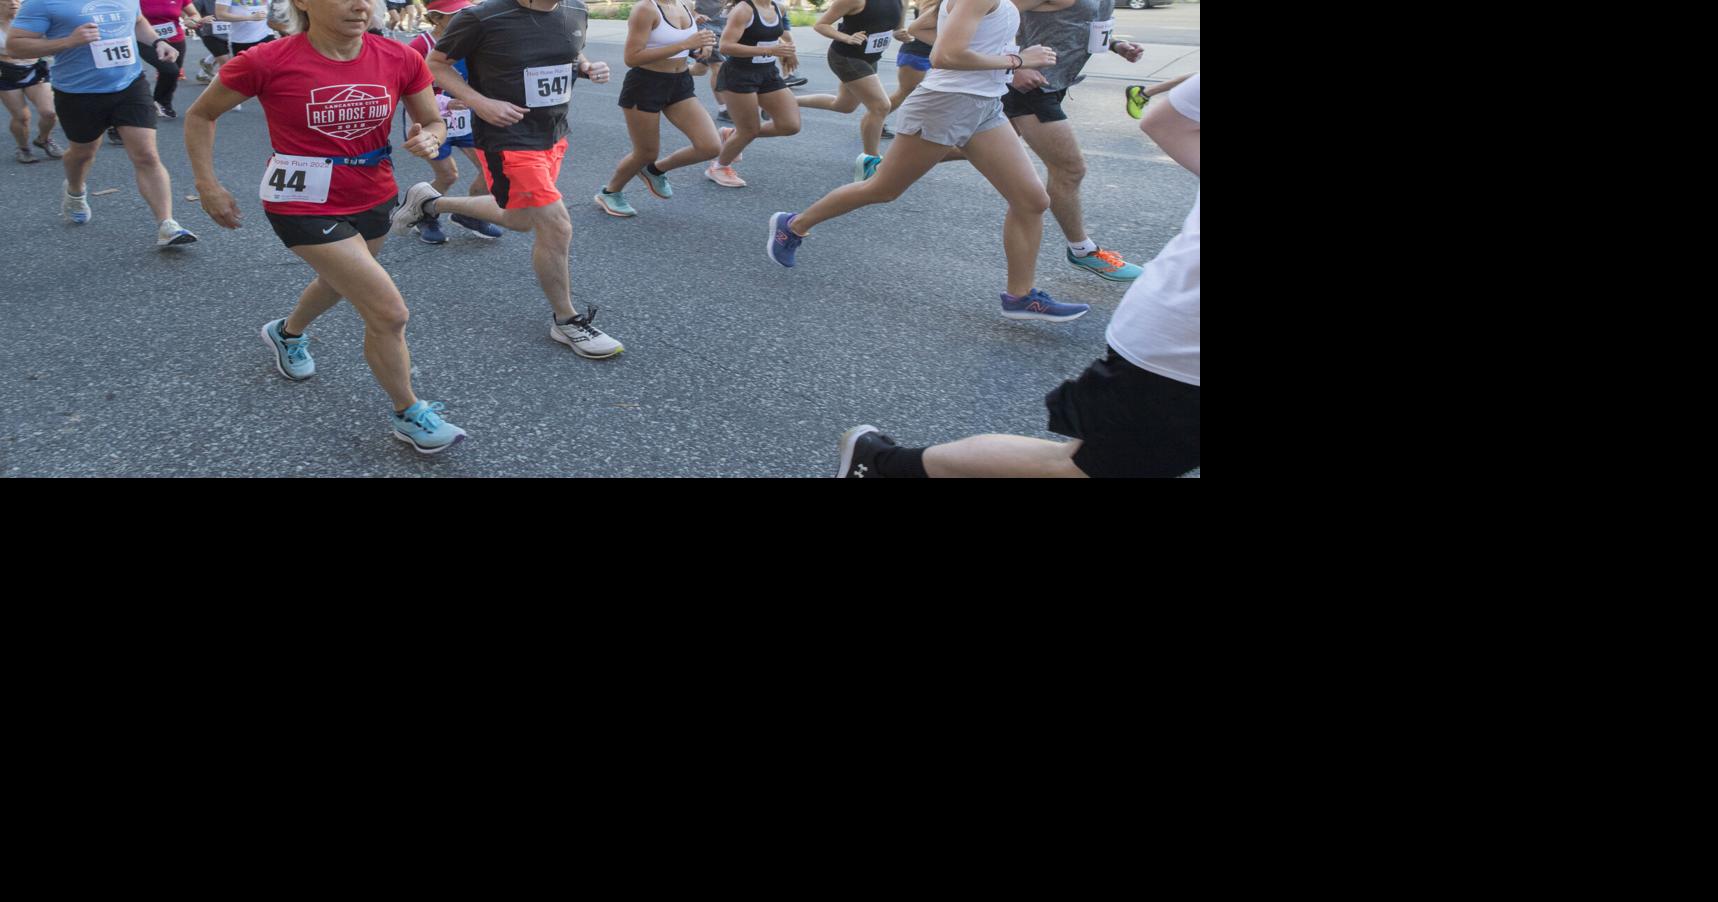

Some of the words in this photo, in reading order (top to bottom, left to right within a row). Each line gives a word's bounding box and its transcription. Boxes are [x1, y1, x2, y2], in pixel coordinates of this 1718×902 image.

[103, 45, 131, 61] 115
[537, 75, 568, 97] 547
[313, 109, 335, 124] RED
[338, 106, 366, 122] ROSE
[368, 103, 388, 119] RUN
[273, 158, 290, 166] ose
[268, 168, 306, 193] 44
